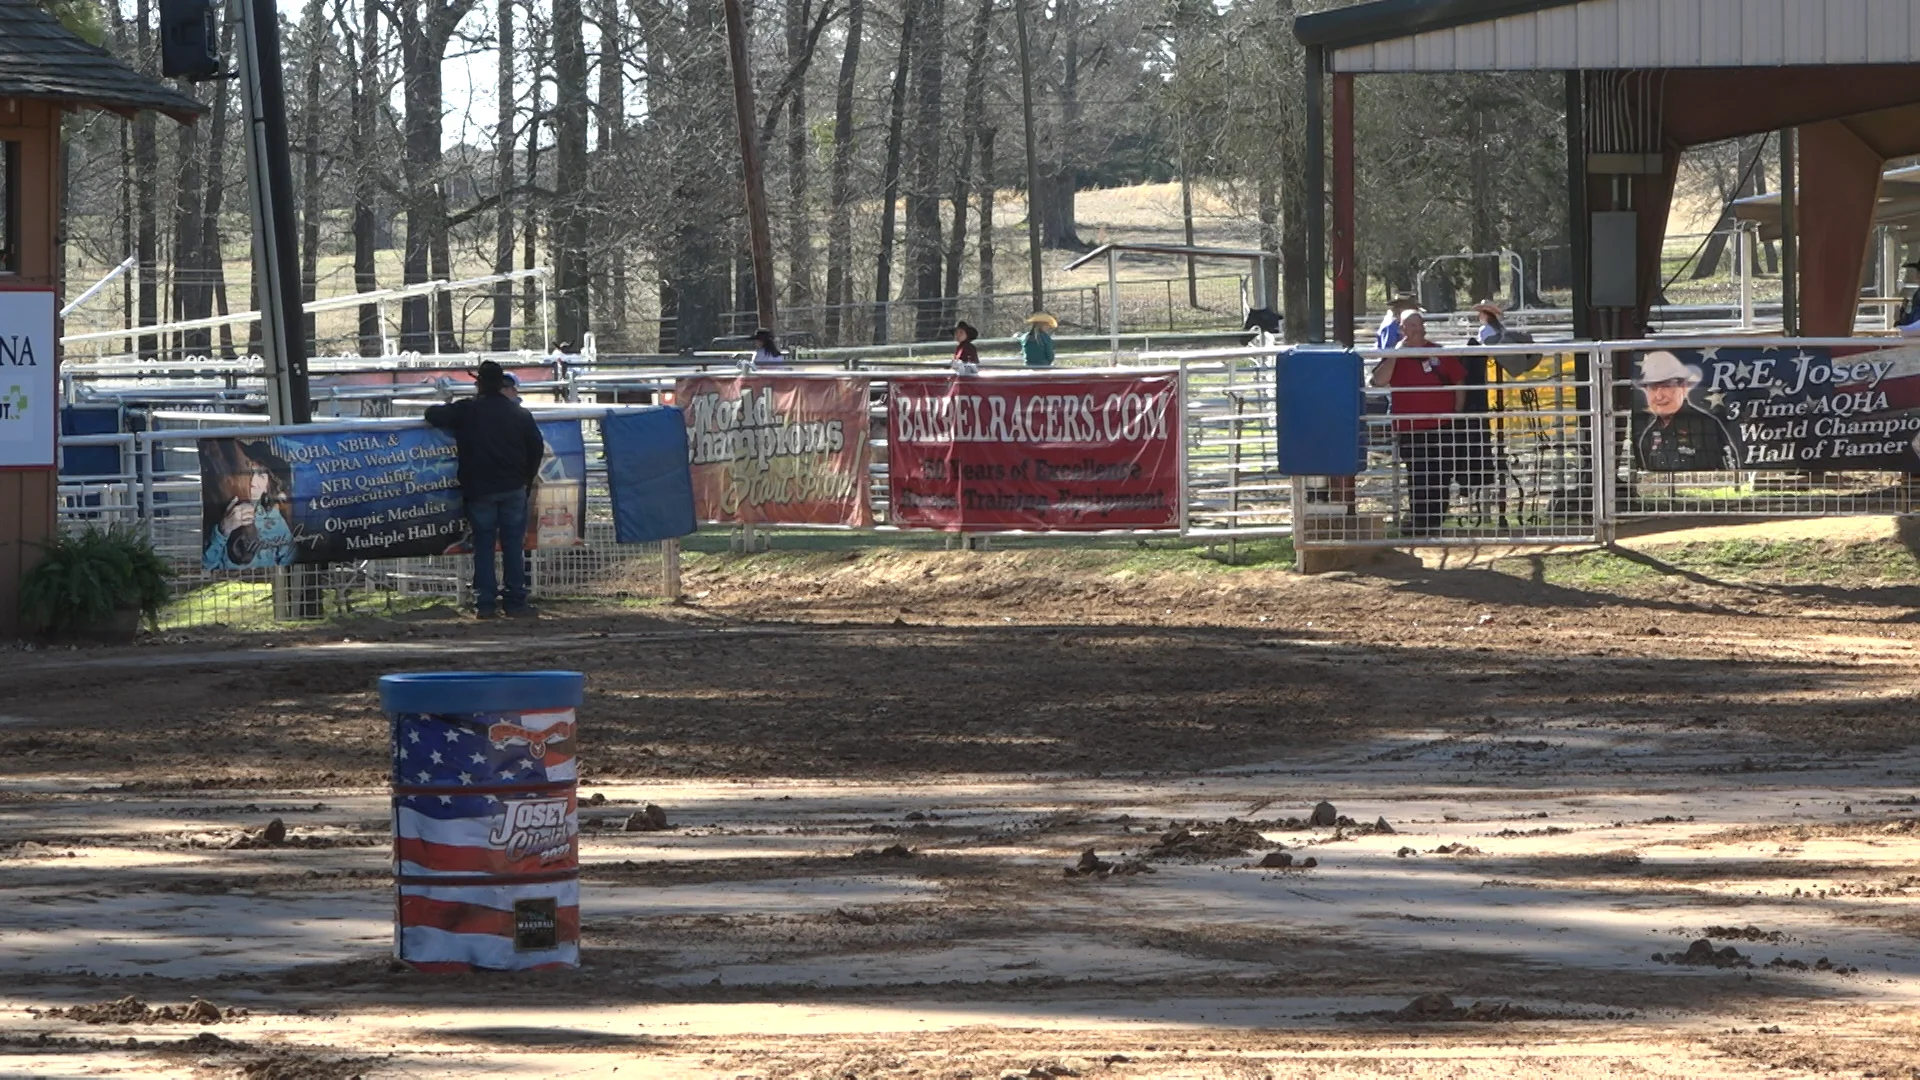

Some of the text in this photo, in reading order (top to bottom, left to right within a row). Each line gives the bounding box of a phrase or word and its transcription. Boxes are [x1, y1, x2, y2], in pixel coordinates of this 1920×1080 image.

[1708, 355, 1894, 395] R.E. Josey
[691, 386, 778, 434] World
[1726, 391, 1889, 421] 3 Time AQHA
[687, 418, 844, 473] hampions
[1739, 420, 1808, 443] World
[284, 432, 400, 464] AQHA, NBHA, &
[315, 456, 363, 475] WPRA
[364, 447, 407, 468] World
[1744, 439, 1909, 465] Hall of Famer
[320, 468, 415, 495] NFR Qualifier
[1010, 459, 1029, 480] of
[308, 475, 461, 511] 4 Consecutive Decades
[324, 500, 447, 534] Olympic Medalist
[345, 529, 406, 551] Multiple
[407, 522, 438, 541] Hall
[439, 518, 456, 535] of
[489, 800, 569, 846] JOSEY
